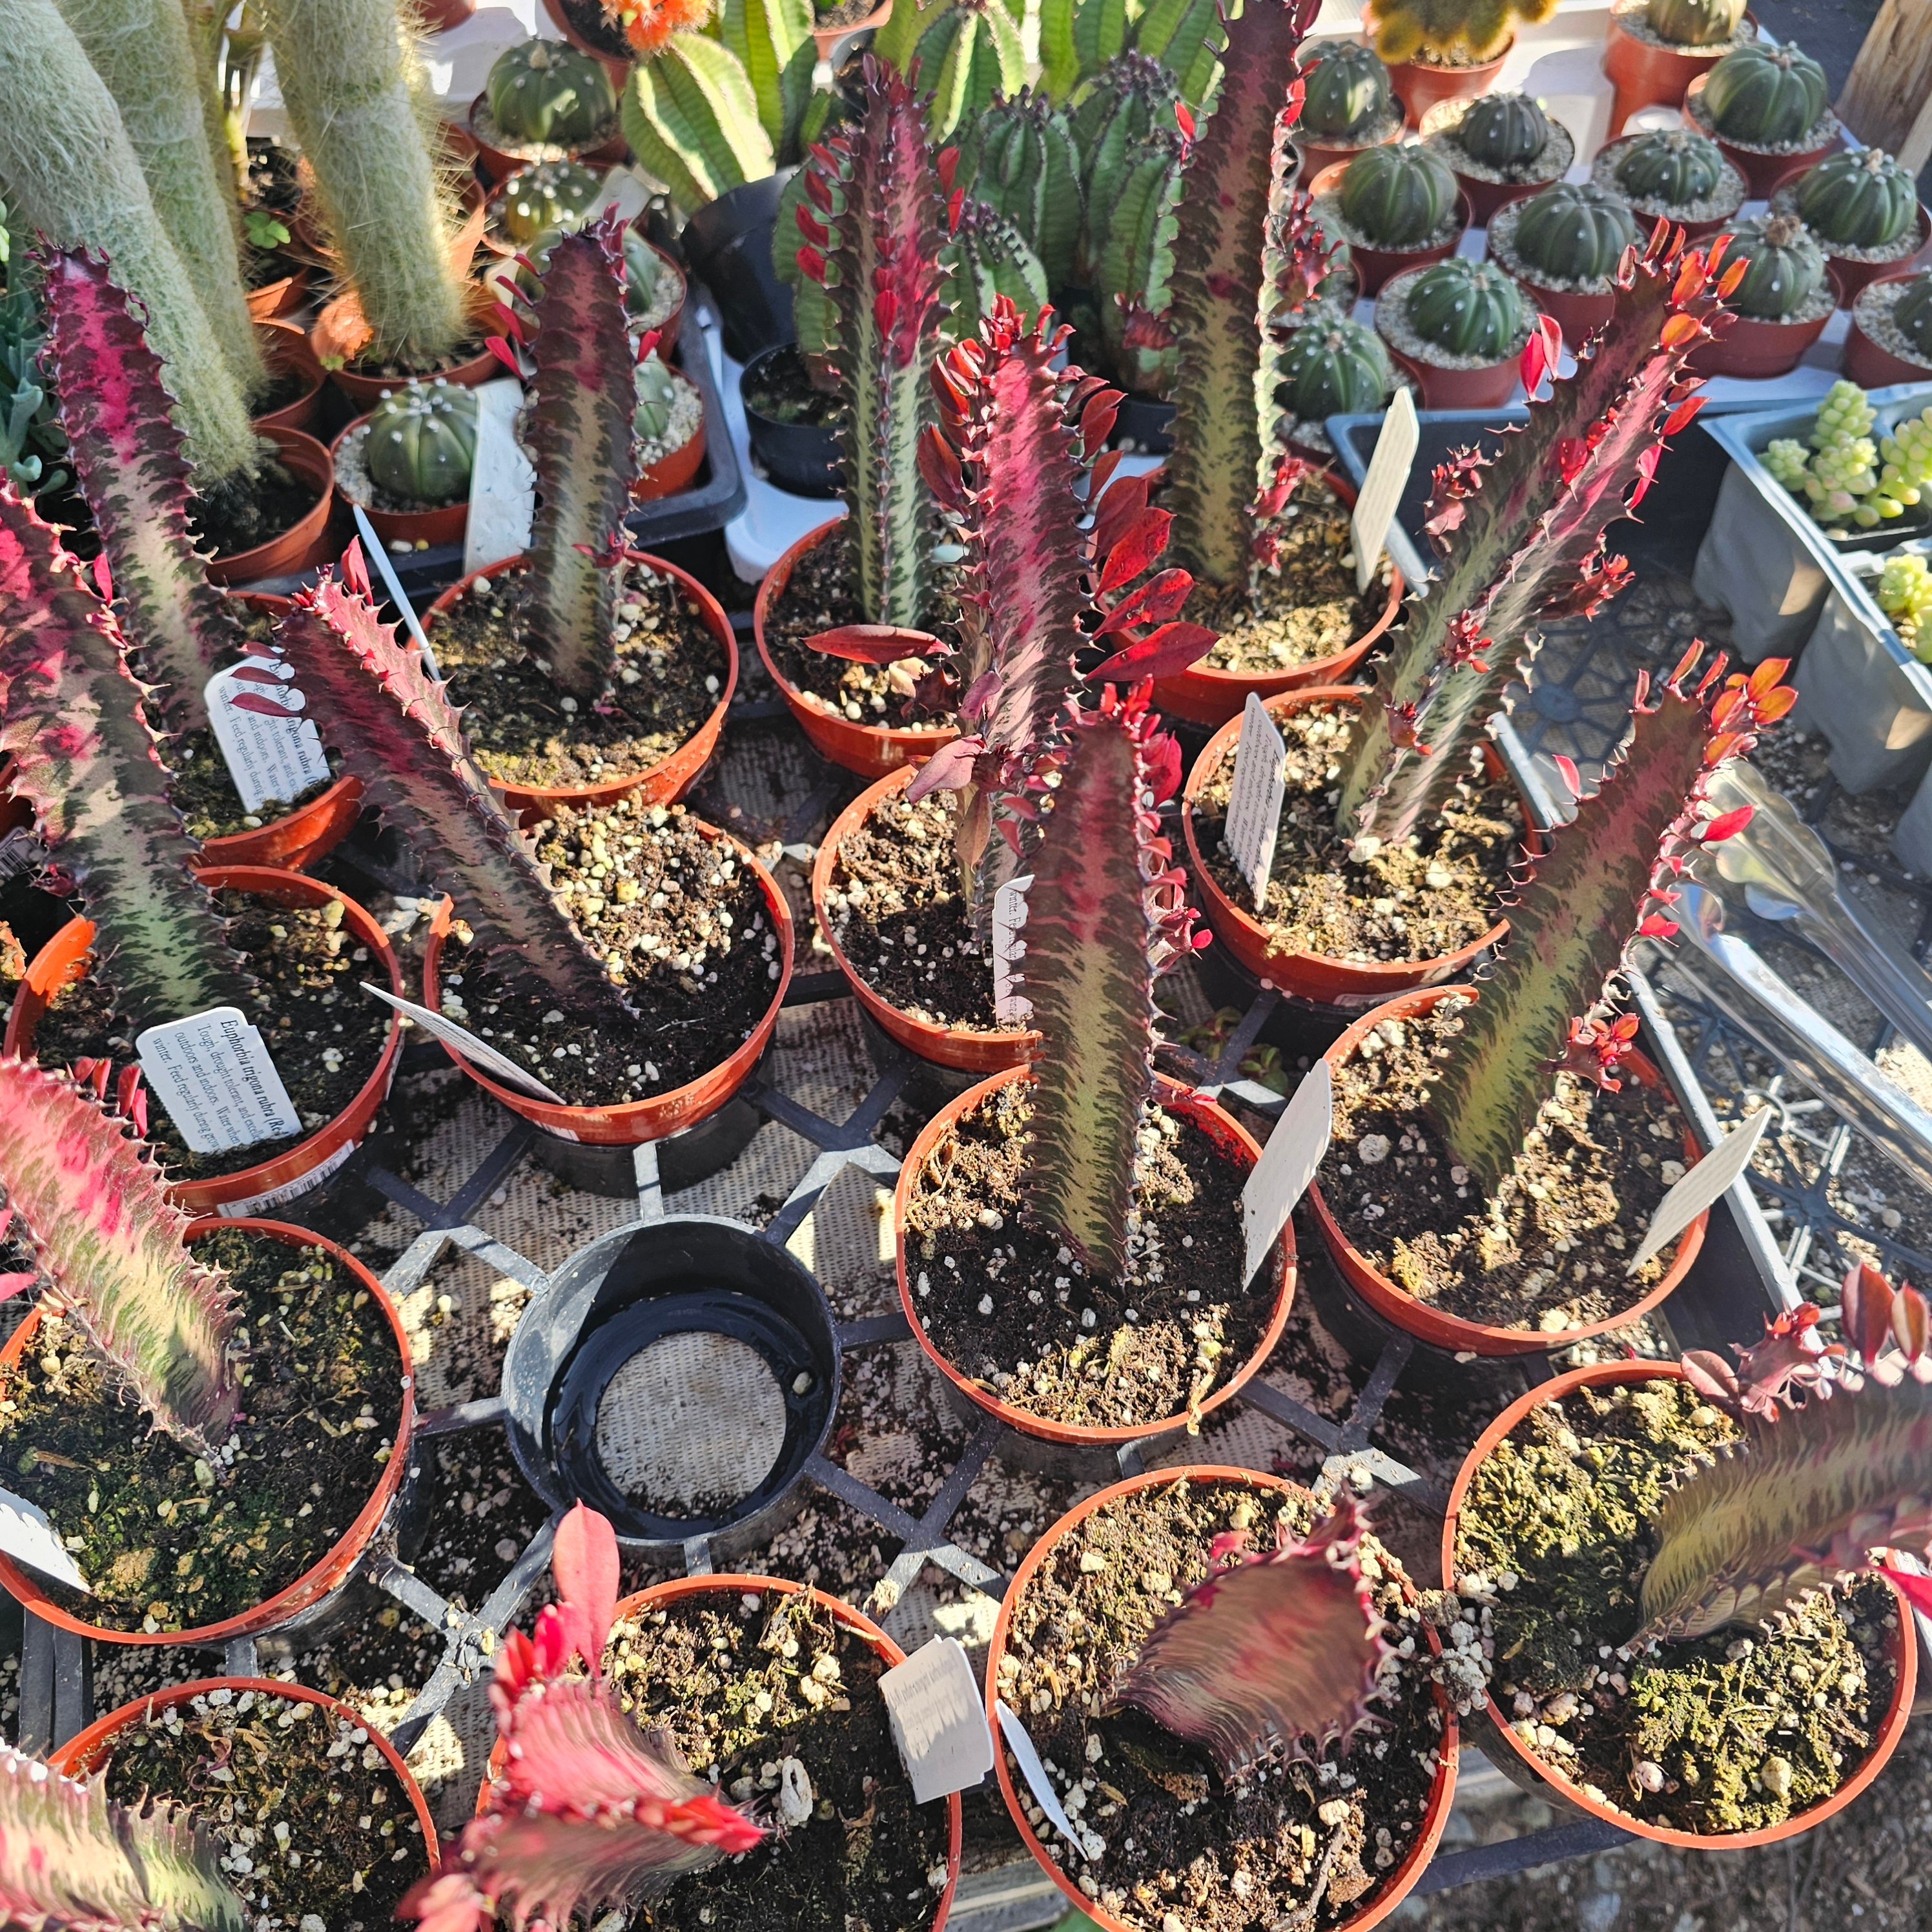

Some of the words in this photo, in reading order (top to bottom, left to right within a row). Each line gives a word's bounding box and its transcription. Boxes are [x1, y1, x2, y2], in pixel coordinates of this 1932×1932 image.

[229, 716, 245, 737] Feed
[247, 715, 261, 730] and
[236, 738, 254, 770] regularly
[253, 731, 269, 762] indoors.
[272, 731, 287, 763] tolerant,
[283, 765, 294, 777] and
[297, 750, 312, 774] rubra
[250, 771, 263, 796] during
[267, 763, 279, 787] Water
[1009, 891, 1017, 914] winter.
[152, 1038, 172, 1063] winter.
[174, 1032, 198, 1064] outdoors
[167, 1064, 187, 1083] Feed
[191, 1064, 210, 1078] and
[197, 1023, 219, 1052] Tough,
[210, 1051, 232, 1078] drought
[223, 1078, 243, 1107] tolerant,
[238, 1106, 254, 1118] and
[220, 1020, 251, 1065] Euphorbia
[242, 1066, 264, 1094] trigona
[256, 1096, 276, 1116] rubra
[176, 1084, 202, 1111] regularly
[199, 1077, 219, 1105] indoors.
[193, 1111, 211, 1133] during
[216, 1105, 231, 1126] Water
[226, 1126, 240, 1144] when
